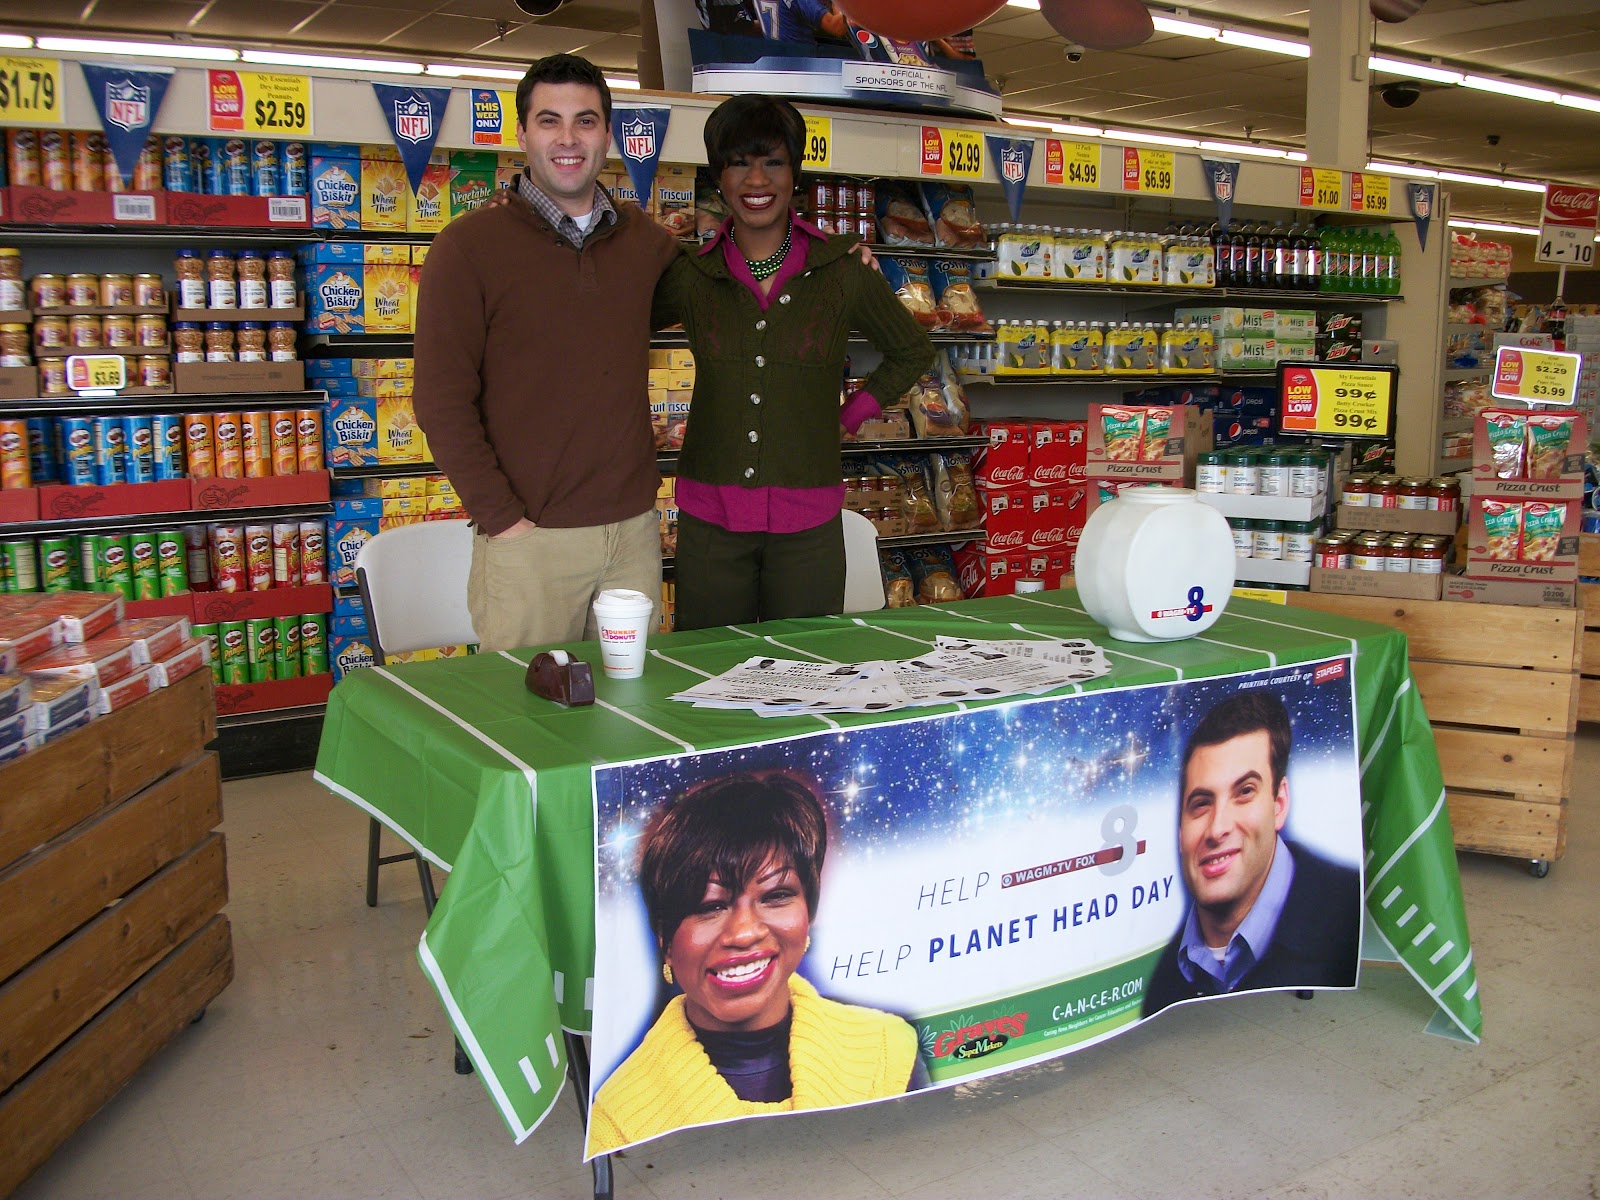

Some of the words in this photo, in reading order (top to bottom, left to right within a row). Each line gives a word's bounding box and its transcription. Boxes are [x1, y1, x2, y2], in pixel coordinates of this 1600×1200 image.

[890, 69, 924, 79] OFFICIAL
[0, 69, 54, 112] $1.79
[212, 85, 237, 94] LOW
[855, 76, 904, 87] SPONSORS
[921, 82, 935, 90] THE
[936, 84, 948, 92] NFL
[111, 100, 145, 123] NFL
[213, 103, 239, 113] LOW
[255, 98, 305, 129] $2.59
[474, 102, 499, 112] THIS
[400, 116, 428, 137] NFL
[475, 119, 501, 128] ONLY
[627, 137, 652, 156] NFL
[949, 139, 980, 174] $2.99
[1004, 163, 1022, 179] NFL
[1069, 162, 1097, 183] $4.99
[316, 179, 356, 192] Chicken
[1145, 169, 1171, 190] $6.99
[321, 190, 353, 203] Biskit
[452, 187, 492, 205] Vegetable
[659, 188, 693, 201] Triscuit
[1216, 184, 1230, 197] NFL
[1318, 188, 1339, 205] $1.00
[372, 193, 397, 206] Wheat
[416, 199, 441, 210] Wheat
[1366, 194, 1387, 210] $5.99
[371, 204, 397, 213] Thins
[415, 209, 441, 219] Thins
[1541, 241, 1552, 257] 4
[321, 285, 360, 297] Chicken
[326, 296, 357, 308] Biskit
[375, 296, 400, 308] Wheat
[374, 307, 400, 317] Thins
[1243, 314, 1262, 327] Mist
[1290, 319, 1304, 327] Mist
[1519, 337, 1543, 347] Coke
[1243, 343, 1265, 356] Mist
[1536, 365, 1568, 375] $2.29
[95, 371, 120, 385] $3.69
[1288, 385, 1312, 395] LOW
[1334, 388, 1377, 400] 99¢
[1532, 384, 1566, 397] $3.99
[1288, 403, 1313, 413] LOW
[1336, 400, 1352, 408] Betty
[335, 419, 374, 431] Chicken
[1333, 413, 1378, 431] 99¢
[340, 429, 370, 442] Biskit
[387, 428, 413, 439] Wheat
[1242, 428, 1259, 436] pepsi
[1536, 433, 1552, 442] Pizza
[1552, 430, 1569, 438] Crust
[387, 438, 413, 447] Thins
[1106, 464, 1133, 473] Pizza
[1135, 464, 1163, 474] Crust
[1496, 482, 1526, 492] Pizza
[1529, 483, 1561, 492] Crust
[1490, 563, 1520, 573] Pizza
[1523, 564, 1555, 575] Crust
[1186, 586, 1204, 622] 8
[339, 654, 375, 667] Chicken
[1238, 679, 1269, 690] PRINTING
[1270, 675, 1301, 685] COURTESY
[1302, 672, 1313, 681] OF
[1315, 664, 1344, 679] STAPLES
[1075, 854, 1096, 868] FOX
[1098, 804, 1138, 877] 8
[918, 871, 990, 911] HELP
[830, 944, 912, 980] HELP
[928, 913, 1039, 963] PLANET
[1052, 892, 1118, 932] HEAD
[1131, 874, 1175, 910] DAY
[1052, 976, 1143, 1021] C-A-N-C-E-R.COM
[1068, 1019, 1088, 1030] Neighbors
[1094, 1013, 1107, 1021] Cancer
[1107, 1006, 1125, 1016] Education
[933, 1011, 1029, 1058] Graves
